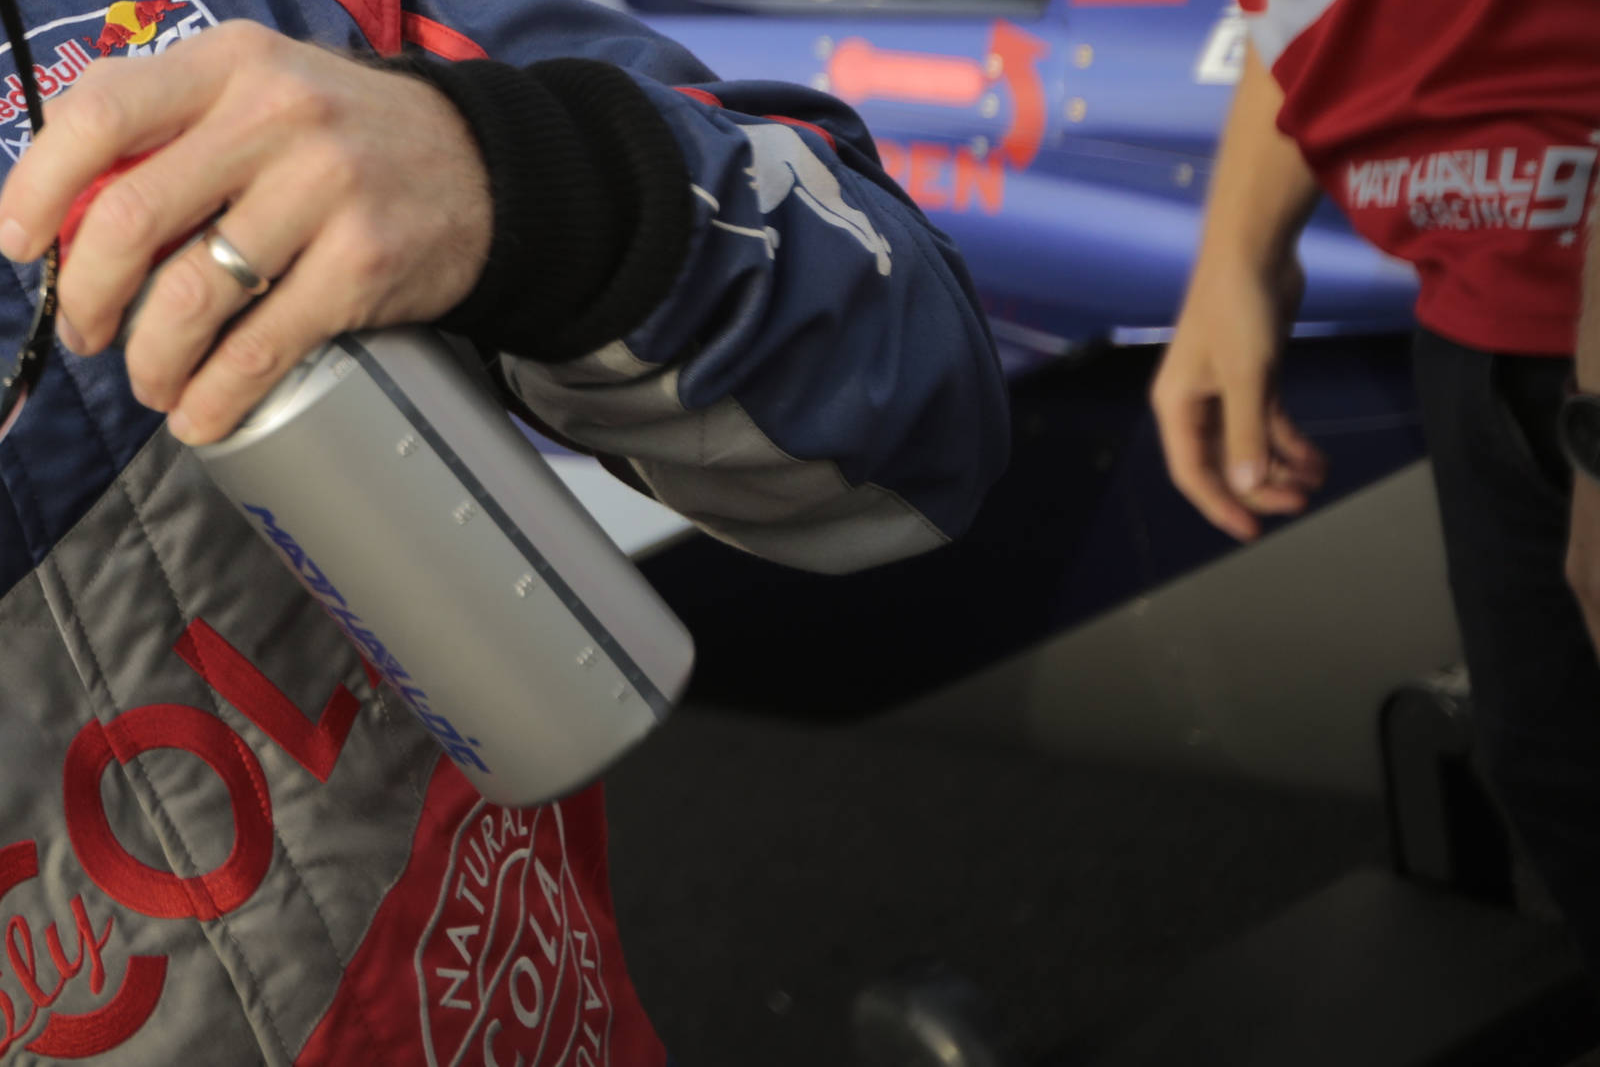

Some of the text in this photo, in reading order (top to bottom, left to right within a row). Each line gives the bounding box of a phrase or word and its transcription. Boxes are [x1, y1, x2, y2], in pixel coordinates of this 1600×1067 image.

[32, 37, 94, 102] Bull
[877, 137, 1005, 216] PEN
[1407, 146, 1535, 208] HALL
[435, 807, 529, 1011] NATURAL
